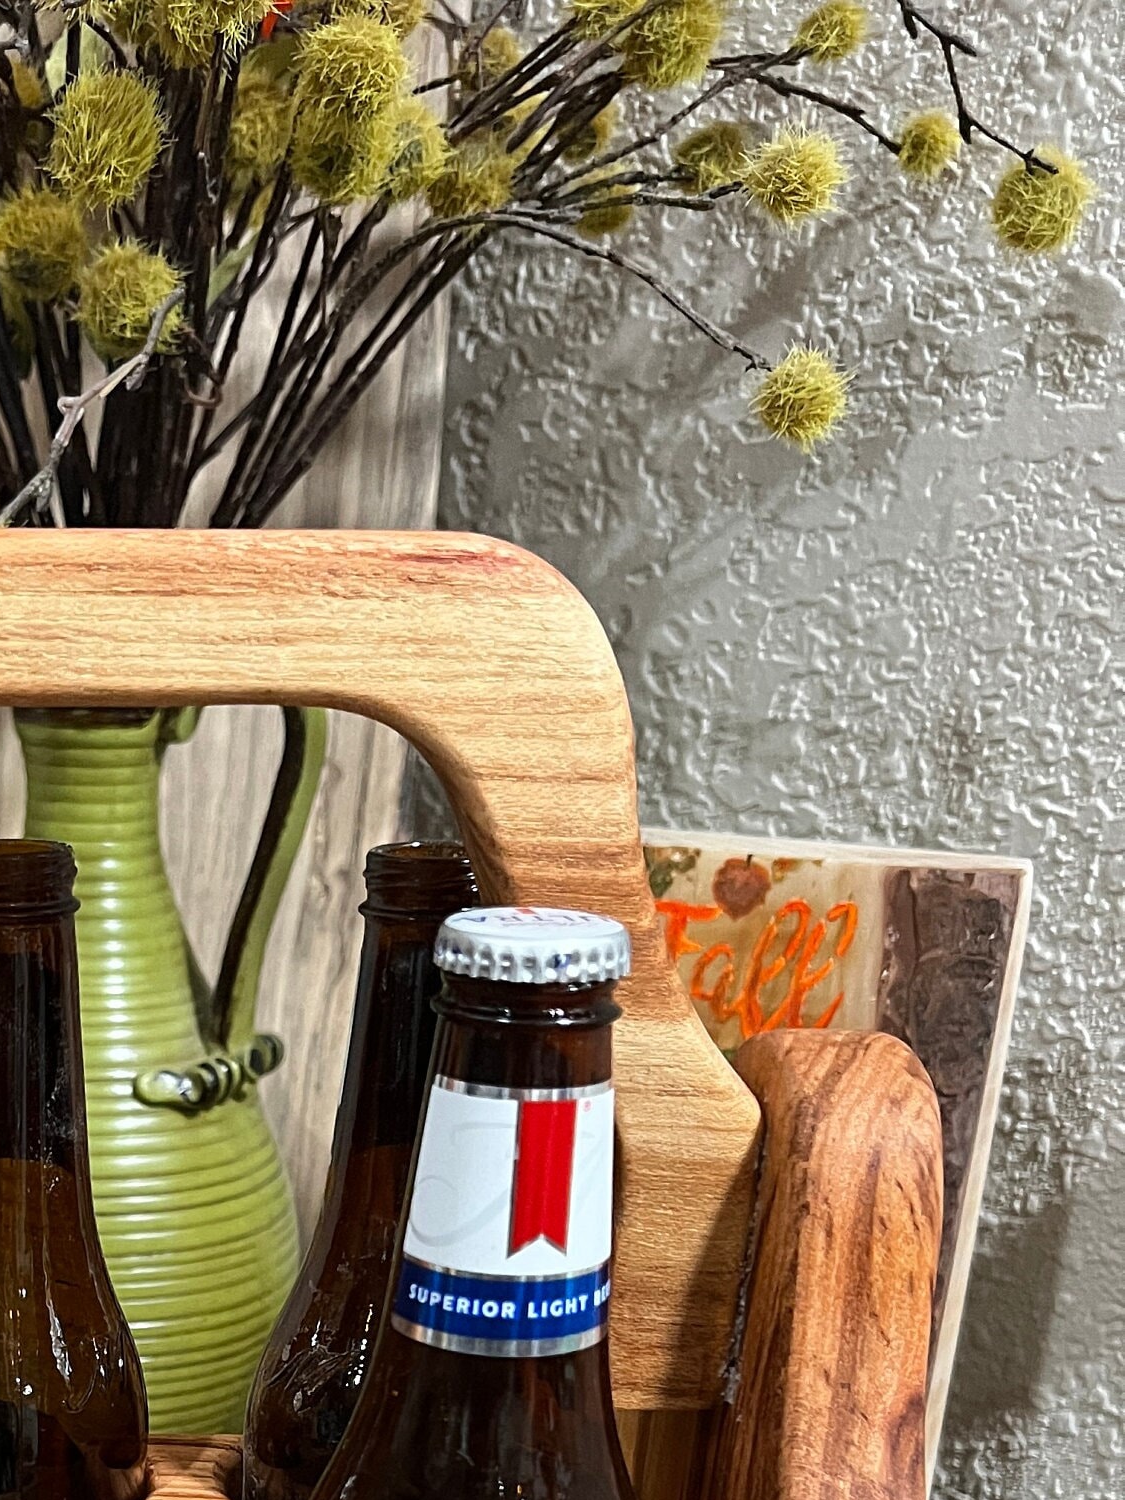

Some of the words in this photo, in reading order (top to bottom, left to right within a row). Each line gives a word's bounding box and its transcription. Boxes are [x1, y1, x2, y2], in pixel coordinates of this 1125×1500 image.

[655, 898, 857, 1040] Fall
[408, 1283, 516, 1319] SUPERIOR
[527, 1292, 588, 1319] LIGHT
